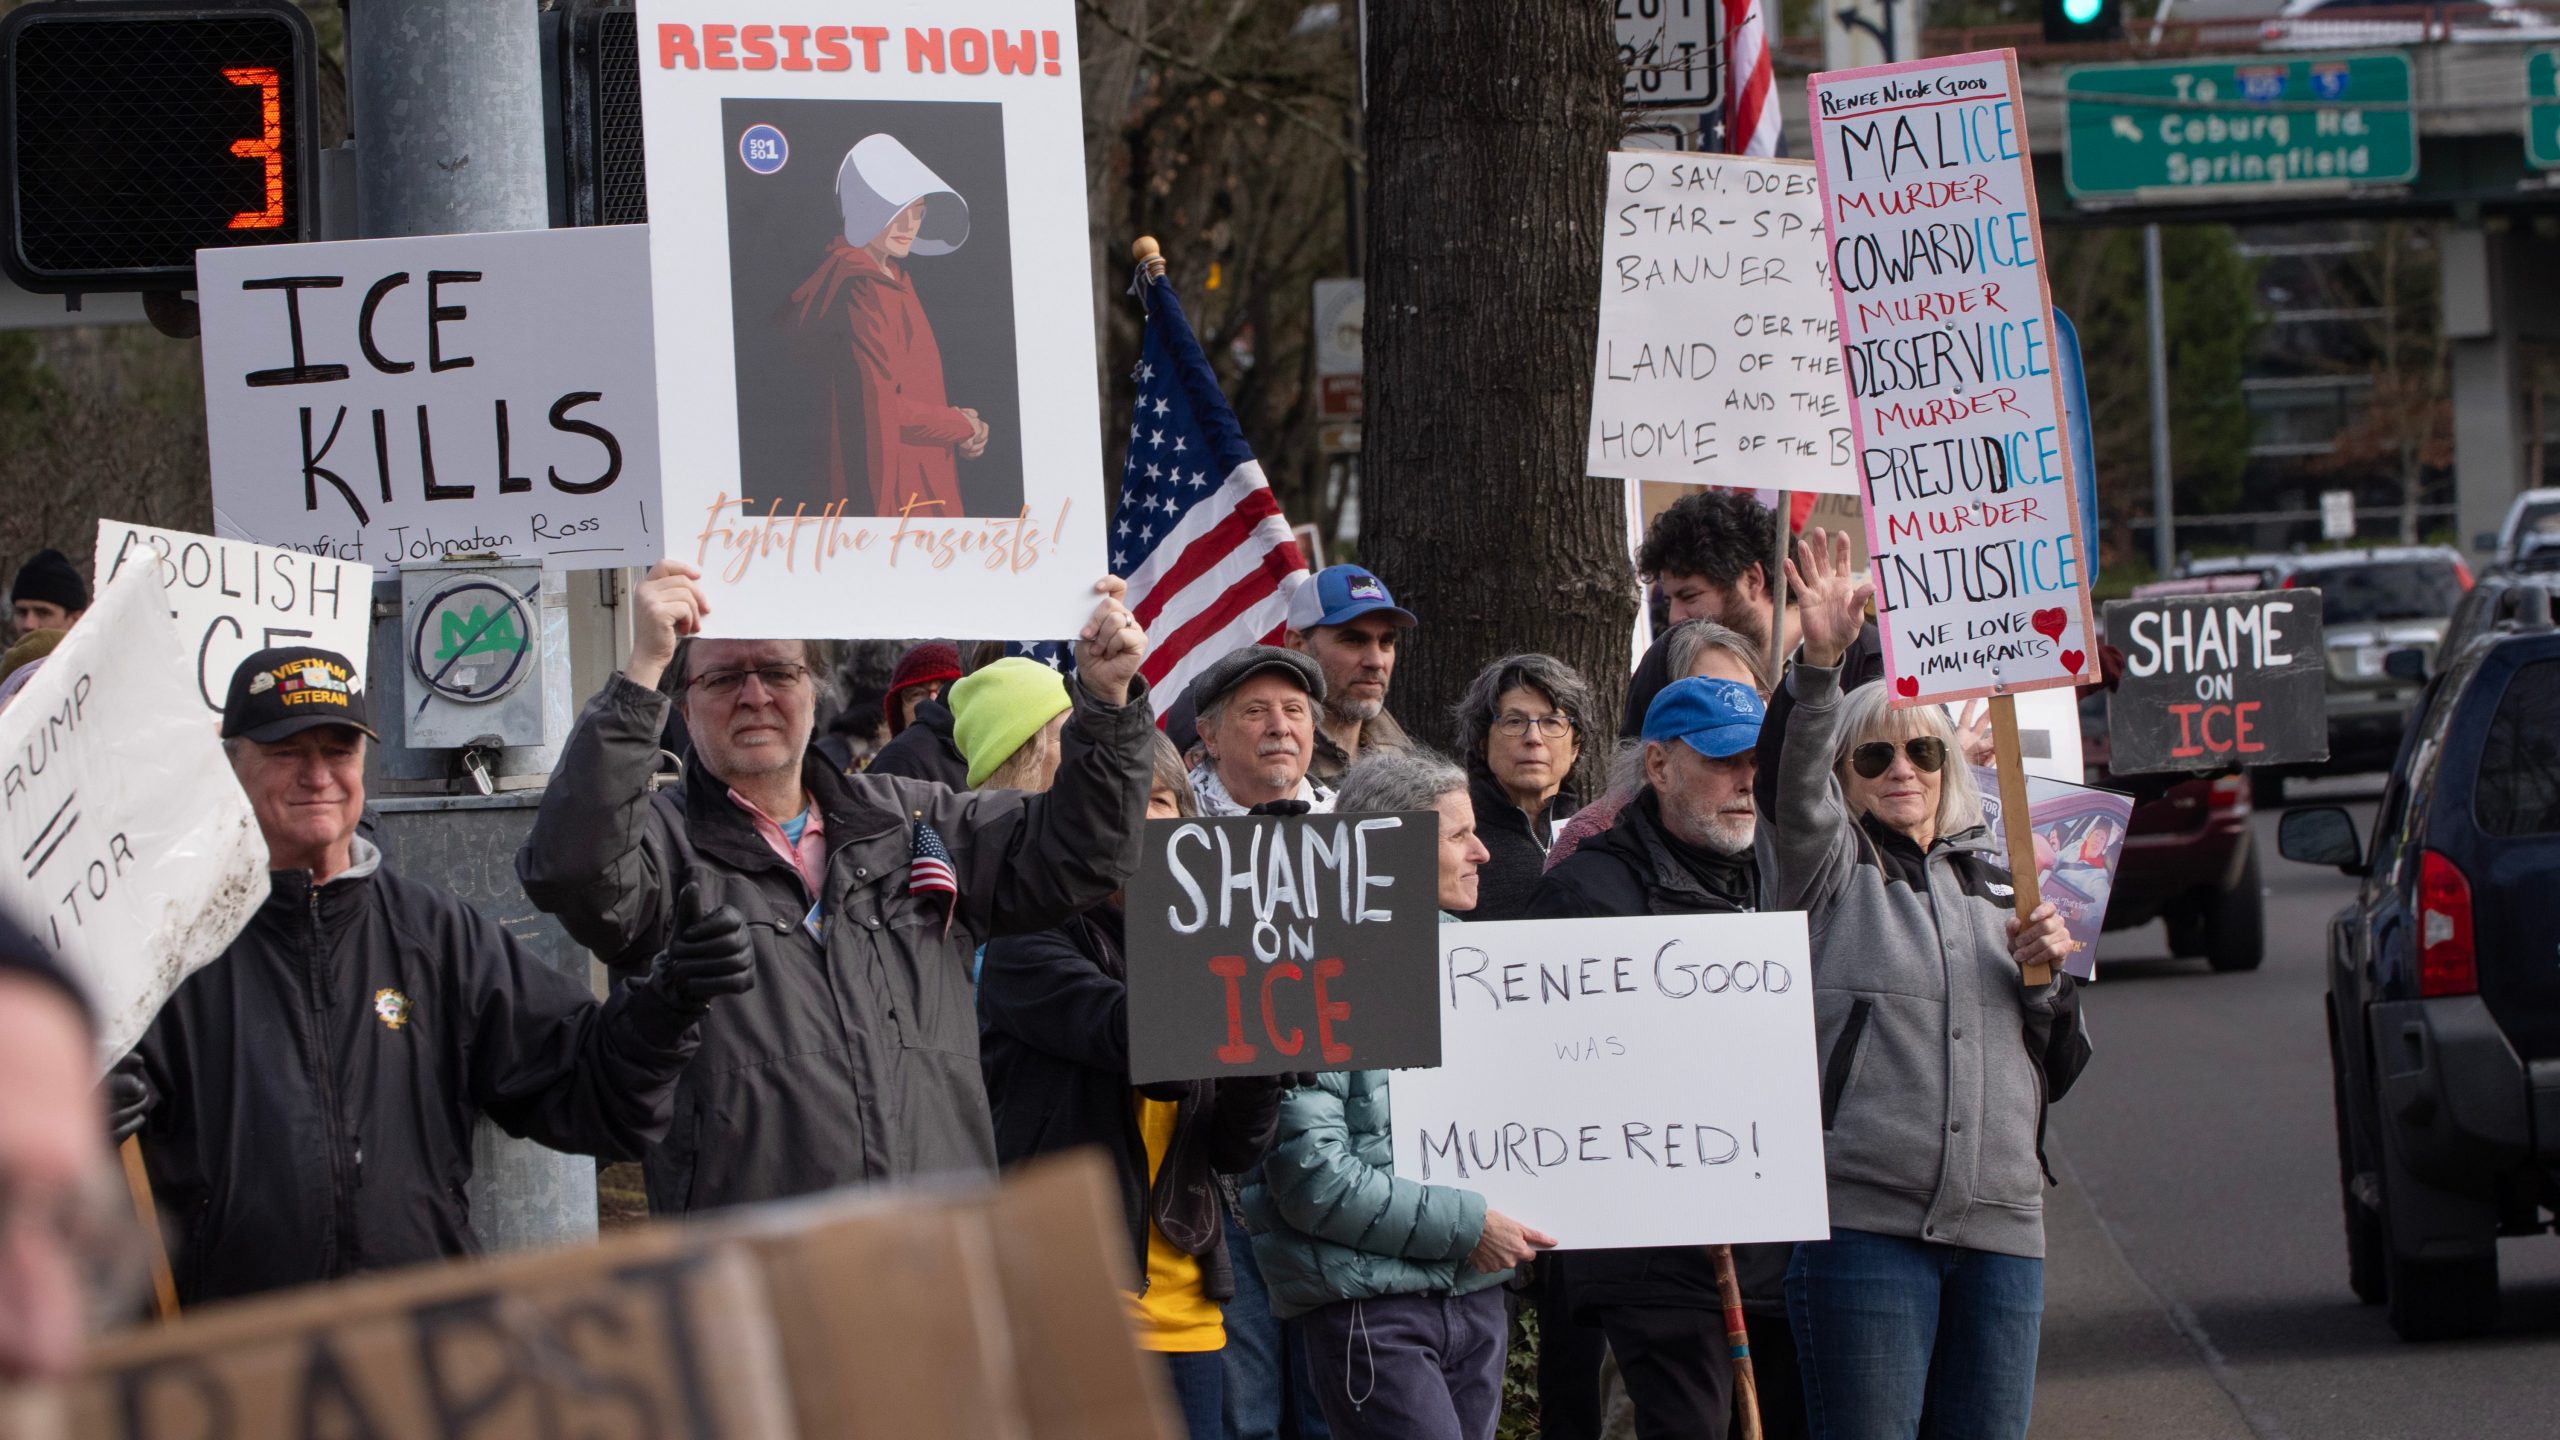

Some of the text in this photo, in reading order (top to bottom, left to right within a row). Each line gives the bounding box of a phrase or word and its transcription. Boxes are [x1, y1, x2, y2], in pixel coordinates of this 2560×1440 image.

[658, 23, 1062, 77] RESIST NOW!
[1818, 90, 1880, 116] RENEE
[2171, 74, 2218, 103] To
[222, 66, 284, 230] 3
[1840, 101, 2025, 182] MALICE
[2159, 109, 2369, 146] Coburg Rd.
[1624, 162, 1654, 193] O
[1744, 169, 1817, 196] DOES
[2166, 146, 2369, 186] Springfield
[1837, 174, 2002, 223] MURDER
[1617, 251, 1792, 294] BANNER
[1834, 212, 2038, 293] COWARDICE
[242, 270, 483, 387] ICE
[1733, 313, 1840, 343] O'ER THE
[1858, 282, 2008, 334] MURDER
[1608, 339, 1842, 382] LAND OF THE
[1843, 318, 2050, 399] DISSERVICE
[1724, 388, 1840, 417] AND THE
[1874, 387, 2031, 436] MURDER
[299, 391, 622, 528] KILLS
[1601, 419, 1718, 465] HOME
[1738, 435, 1767, 452] OF
[1777, 436, 1818, 456] THE
[1861, 426, 2063, 507] PREJUDICE
[532, 513, 600, 542] Ross
[697, 491, 1072, 584] Fight the Fascists!
[1888, 497, 2048, 545] MURDER
[1871, 533, 2080, 613] INJUSTICE
[1907, 610, 2029, 649] WE LOVE
[2128, 602, 2294, 677] SHAME
[272, 657, 347, 681] VIETNAM
[1920, 639, 2050, 676] IMMIGRANTS
[281, 689, 348, 707] VETERAN
[2195, 672, 2234, 701] ON
[2167, 701, 2265, 758] ICE
[1166, 816, 1403, 935] SHAME
[1252, 920, 1315, 964] ON
[1446, 938, 1793, 1010] RENEE GOOD
[1207, 955, 1354, 1064] ICE
[1555, 1036, 1627, 1062] WAS
[1420, 1120, 1763, 1181] MURDERED!
